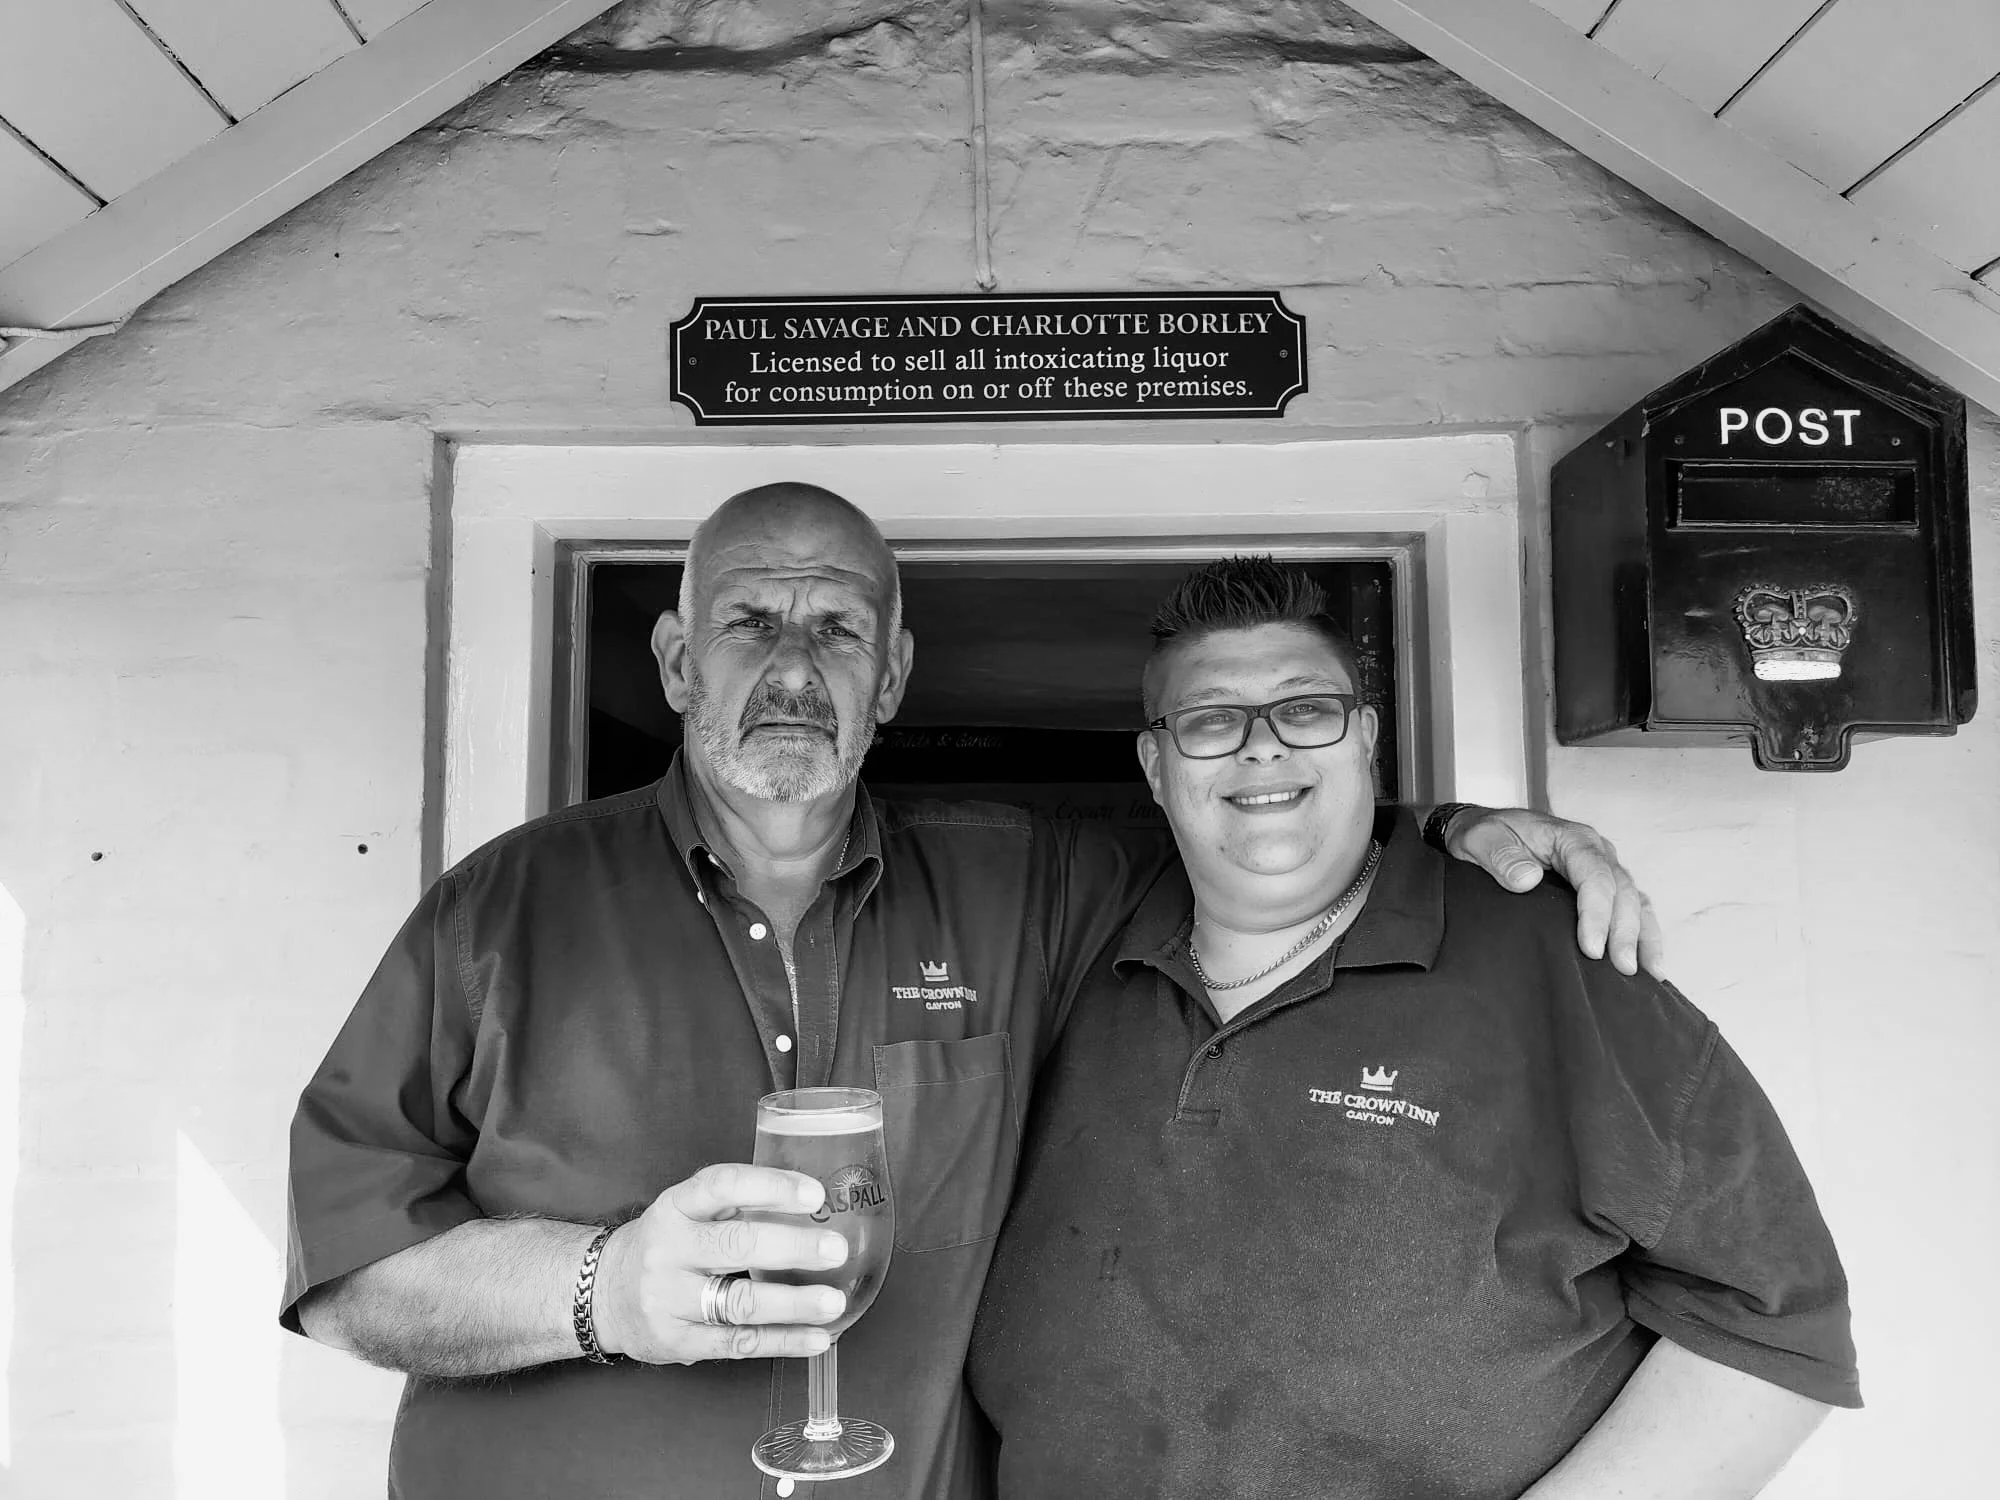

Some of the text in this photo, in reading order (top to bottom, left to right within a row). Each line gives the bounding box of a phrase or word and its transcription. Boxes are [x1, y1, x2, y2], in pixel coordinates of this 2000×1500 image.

[703, 311, 1273, 340] PAUL SAVAGE AND CHARLOTTE BORLEY
[749, 345, 1229, 375] Licensed to sell all intoxicating liquor
[724, 373, 1254, 408] for consumption on or off these premises.
[1719, 407, 1861, 446] POST
[892, 986, 920, 999] THE
[920, 986, 964, 1000] CROWN
[925, 1000, 962, 1011] GAYTON
[1308, 1088, 1440, 1126] THE CROWN INN
[1345, 1109, 1395, 1126] GAYTON
